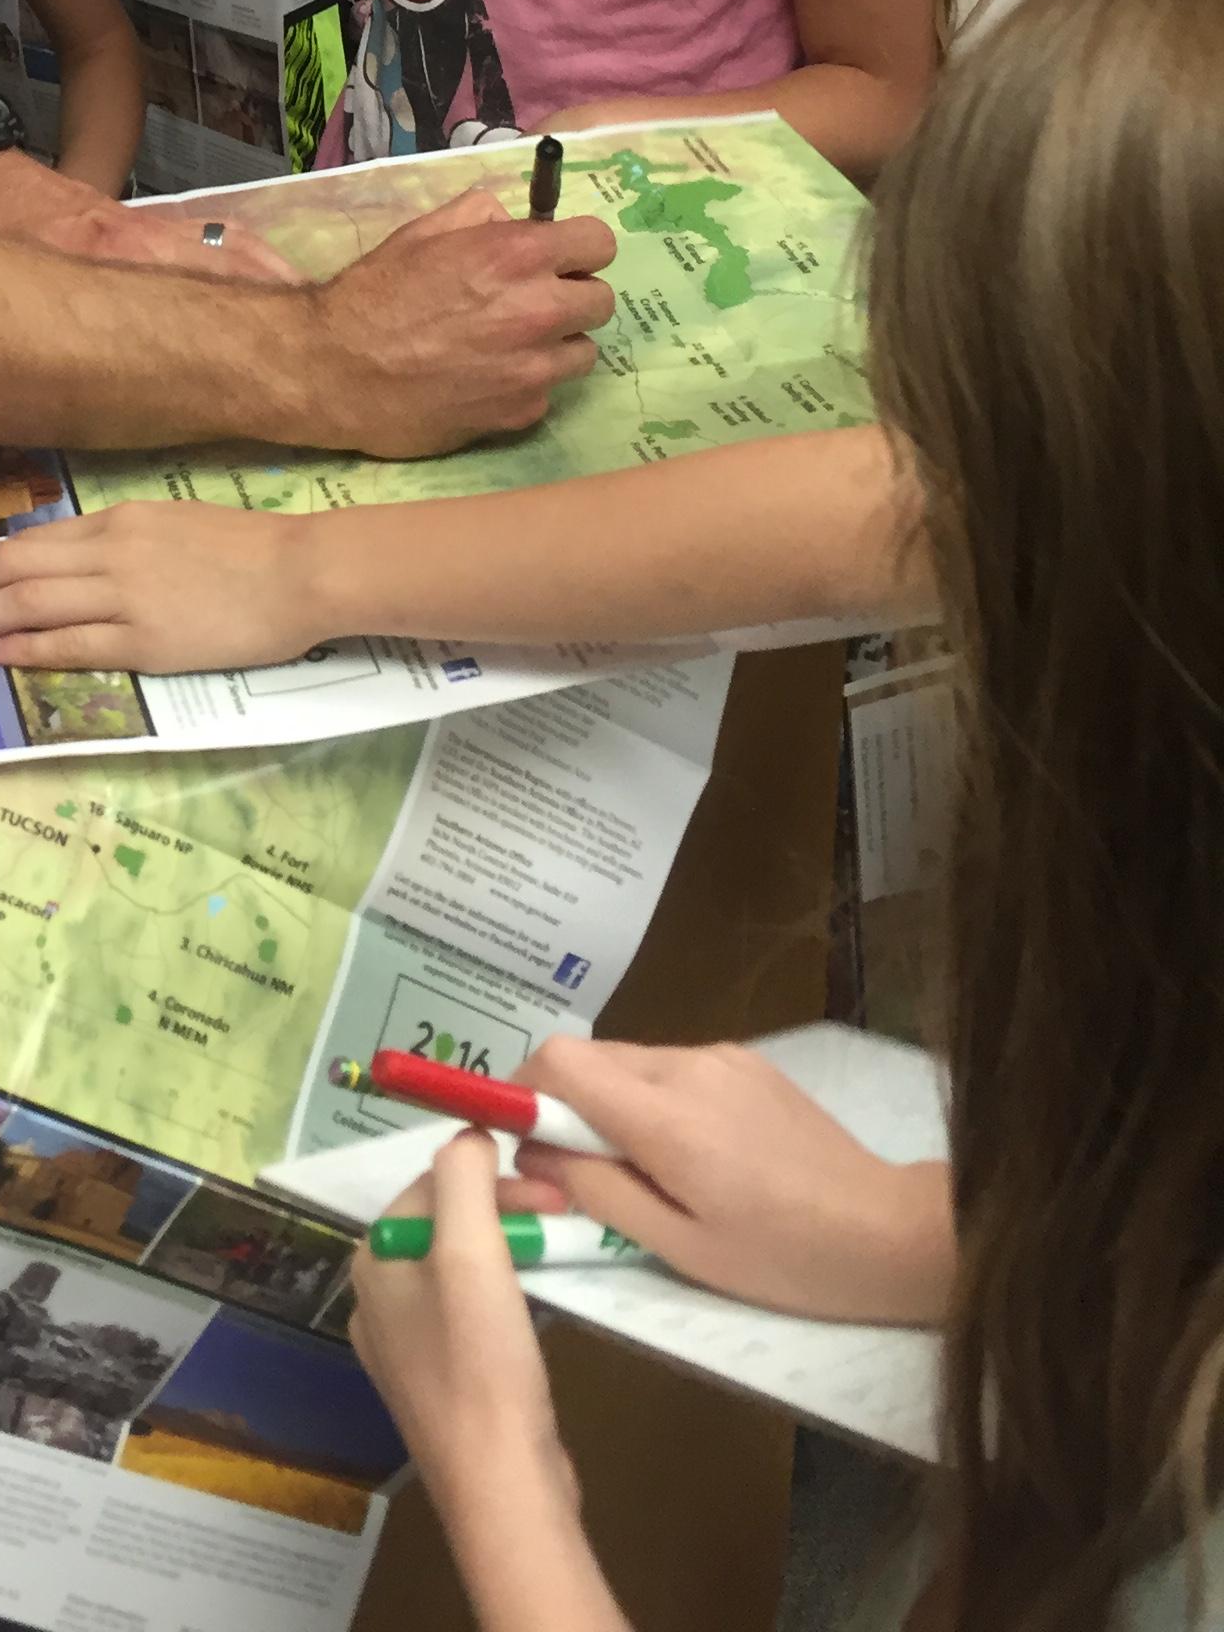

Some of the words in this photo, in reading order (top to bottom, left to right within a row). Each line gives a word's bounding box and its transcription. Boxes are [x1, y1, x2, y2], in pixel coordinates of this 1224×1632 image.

[0, 806, 69, 847] TUCSON
[115, 810, 172, 846] Saguaro
[174, 838, 194, 855] NP
[279, 849, 310, 873] Fort
[163, 994, 232, 1035] Coronado
